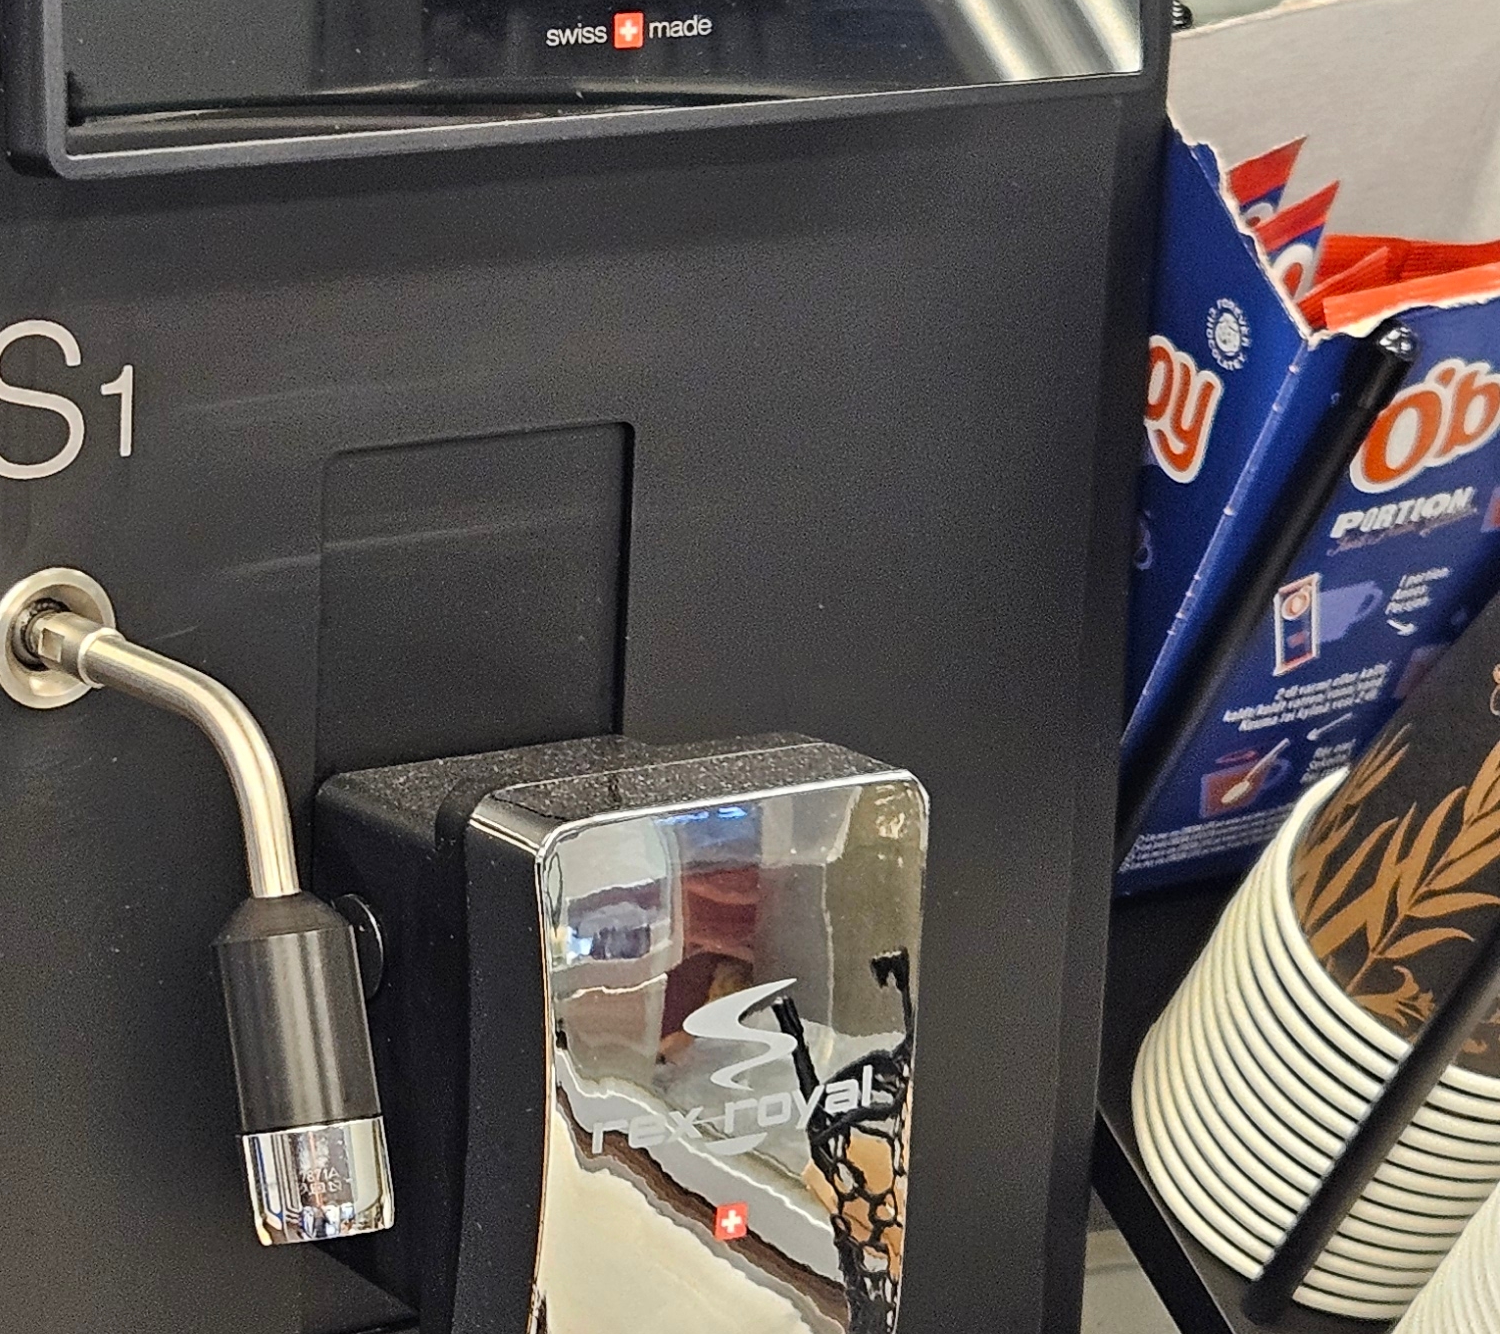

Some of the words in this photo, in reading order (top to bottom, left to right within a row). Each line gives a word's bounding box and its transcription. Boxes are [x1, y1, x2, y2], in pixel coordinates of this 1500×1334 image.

[546, 23, 607, 46] swiss
[649, 14, 712, 38] made
[1329, 486, 1476, 539] PORTION
[592, 1106, 703, 1155] rex
[724, 1065, 874, 1134] royal
